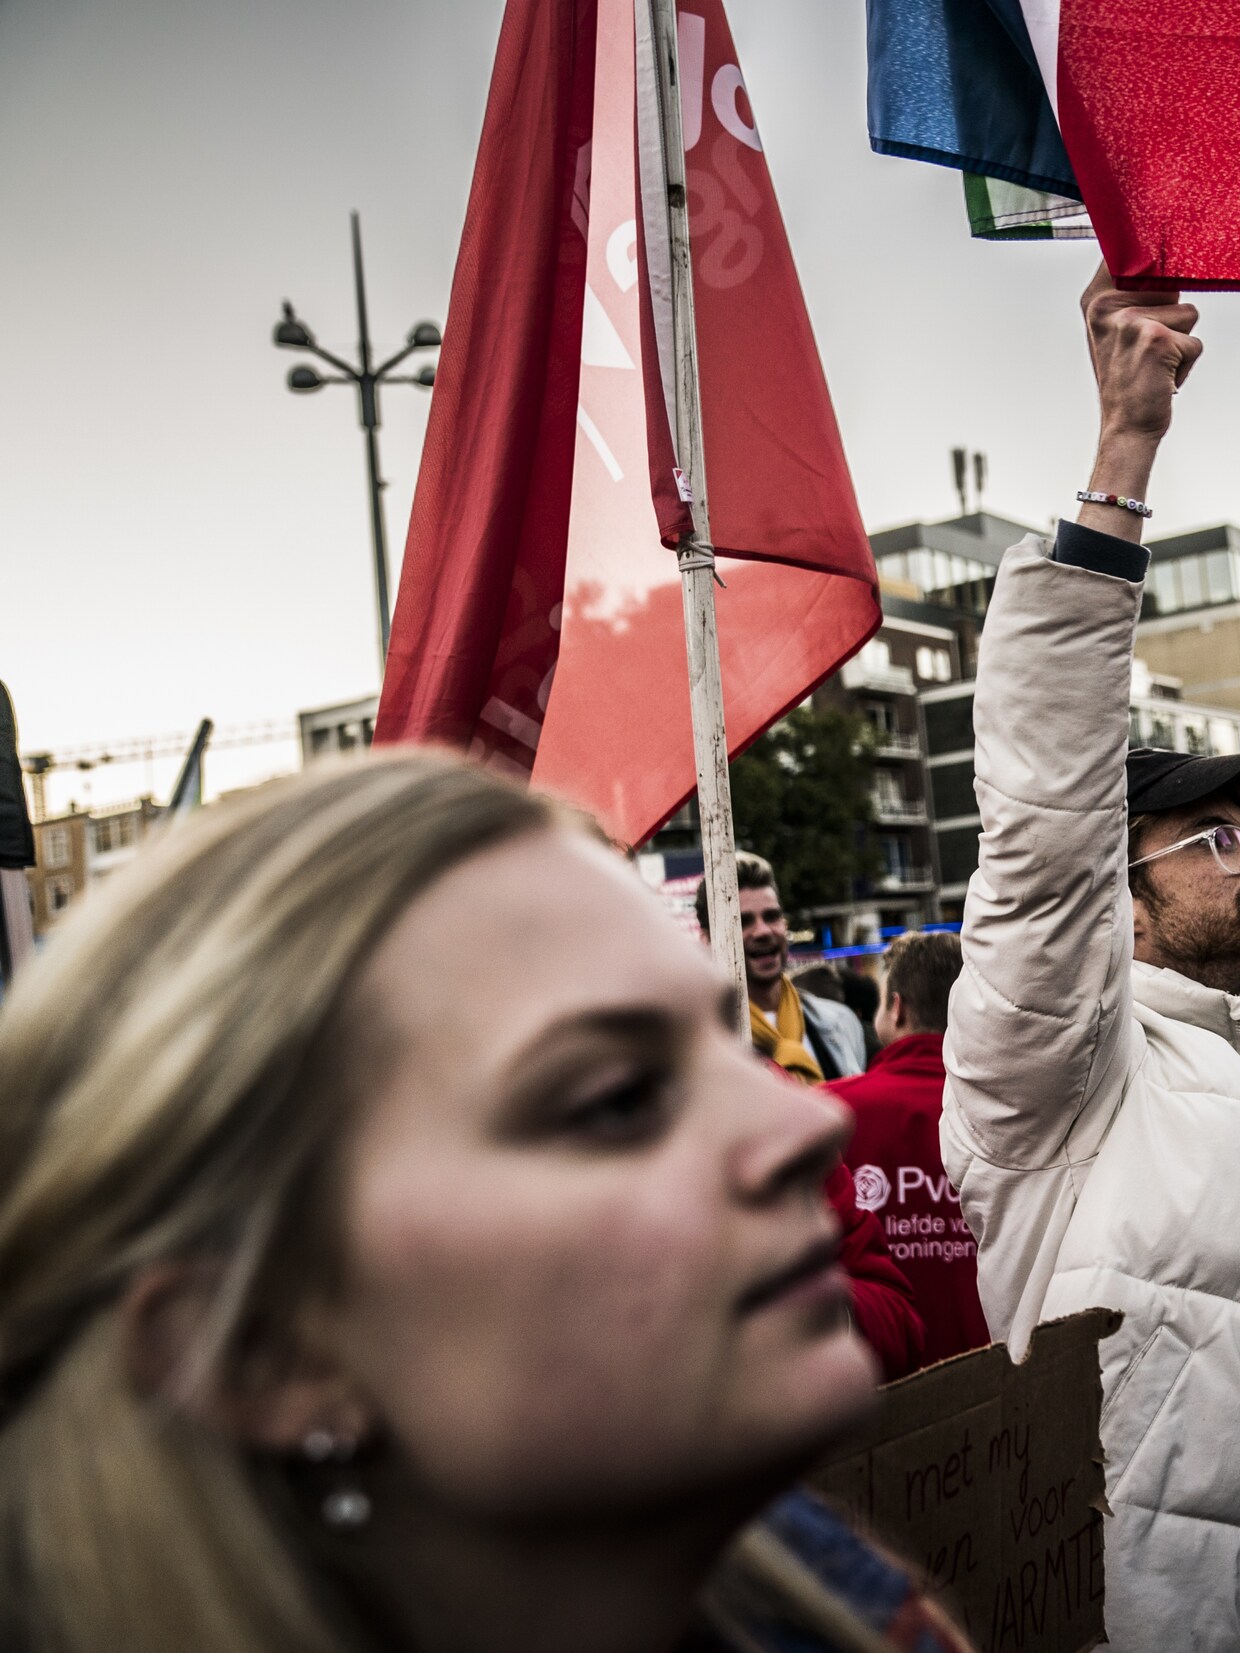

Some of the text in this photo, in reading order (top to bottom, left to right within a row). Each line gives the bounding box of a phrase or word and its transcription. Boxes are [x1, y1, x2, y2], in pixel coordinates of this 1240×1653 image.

[885, 1213, 946, 1236] liefde
[886, 1238, 977, 1263] roningen
[905, 1428, 974, 1523] met
[1009, 1477, 1077, 1545] voor
